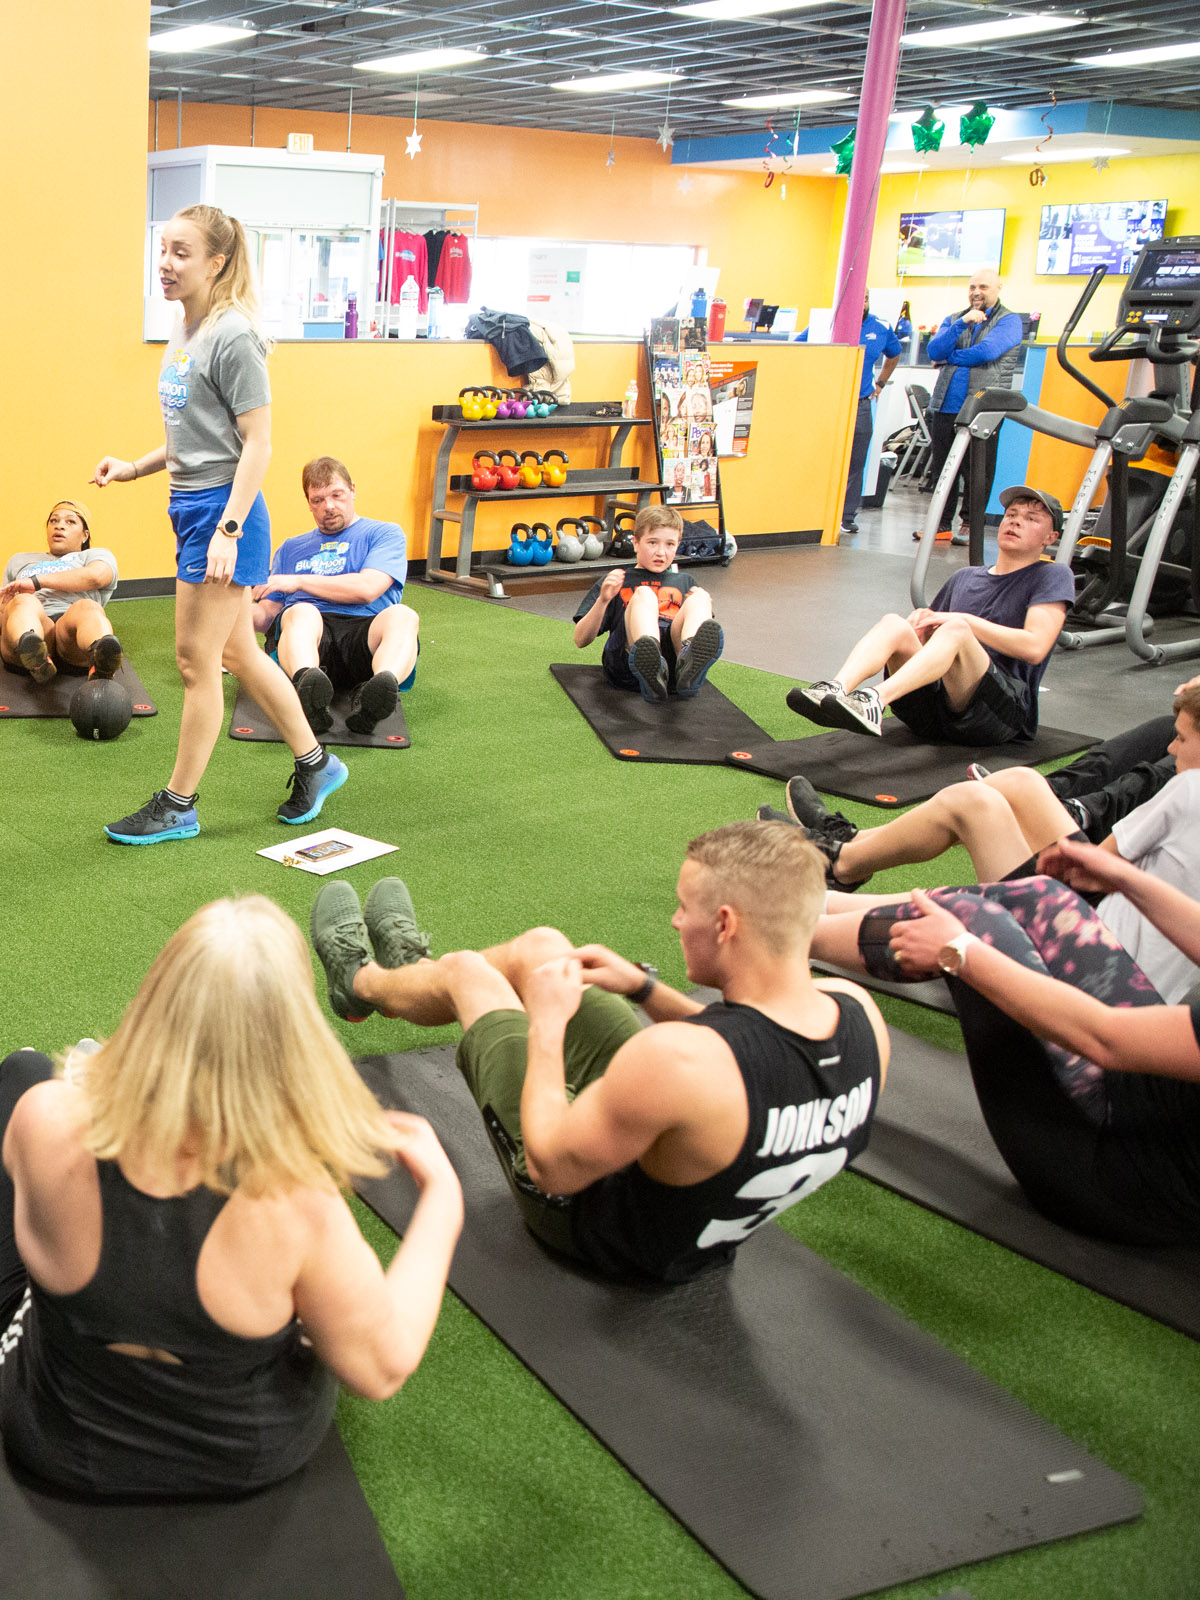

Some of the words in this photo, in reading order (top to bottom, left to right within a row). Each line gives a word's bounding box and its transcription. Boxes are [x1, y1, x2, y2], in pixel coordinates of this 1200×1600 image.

[293, 134, 310, 152] EXIT
[19, 566, 42, 579] Blue
[295, 559, 319, 572] Blue
[319, 557, 346, 570] Moon
[756, 1076, 873, 1158] JOHNSON
